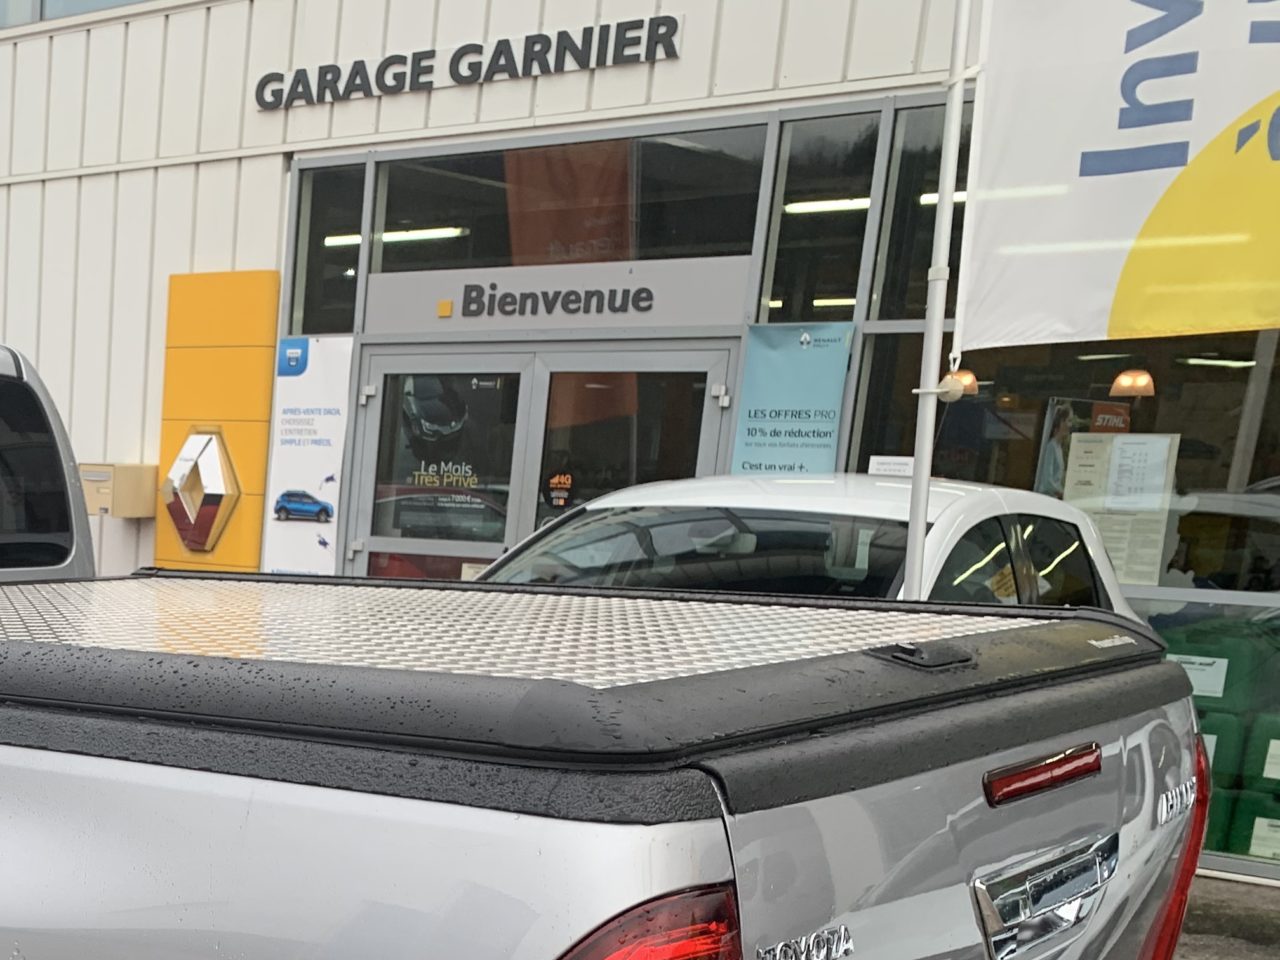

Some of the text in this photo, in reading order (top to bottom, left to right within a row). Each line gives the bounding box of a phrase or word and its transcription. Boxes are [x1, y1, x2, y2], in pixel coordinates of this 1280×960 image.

[255, 15, 679, 110] GARAGE GARNIER
[462, 282, 654, 318] Bienvenue
[748, 409, 836, 420] LES OFFRES PRO
[1095, 414, 1125, 427] STIHL
[769, 429, 782, 438] de
[420, 460, 472, 476] Le Mois
[742, 461, 762, 471] C'est
[764, 463, 776, 471] un
[778, 462, 795, 471] vrai
[443, 472, 478, 488] Privé
